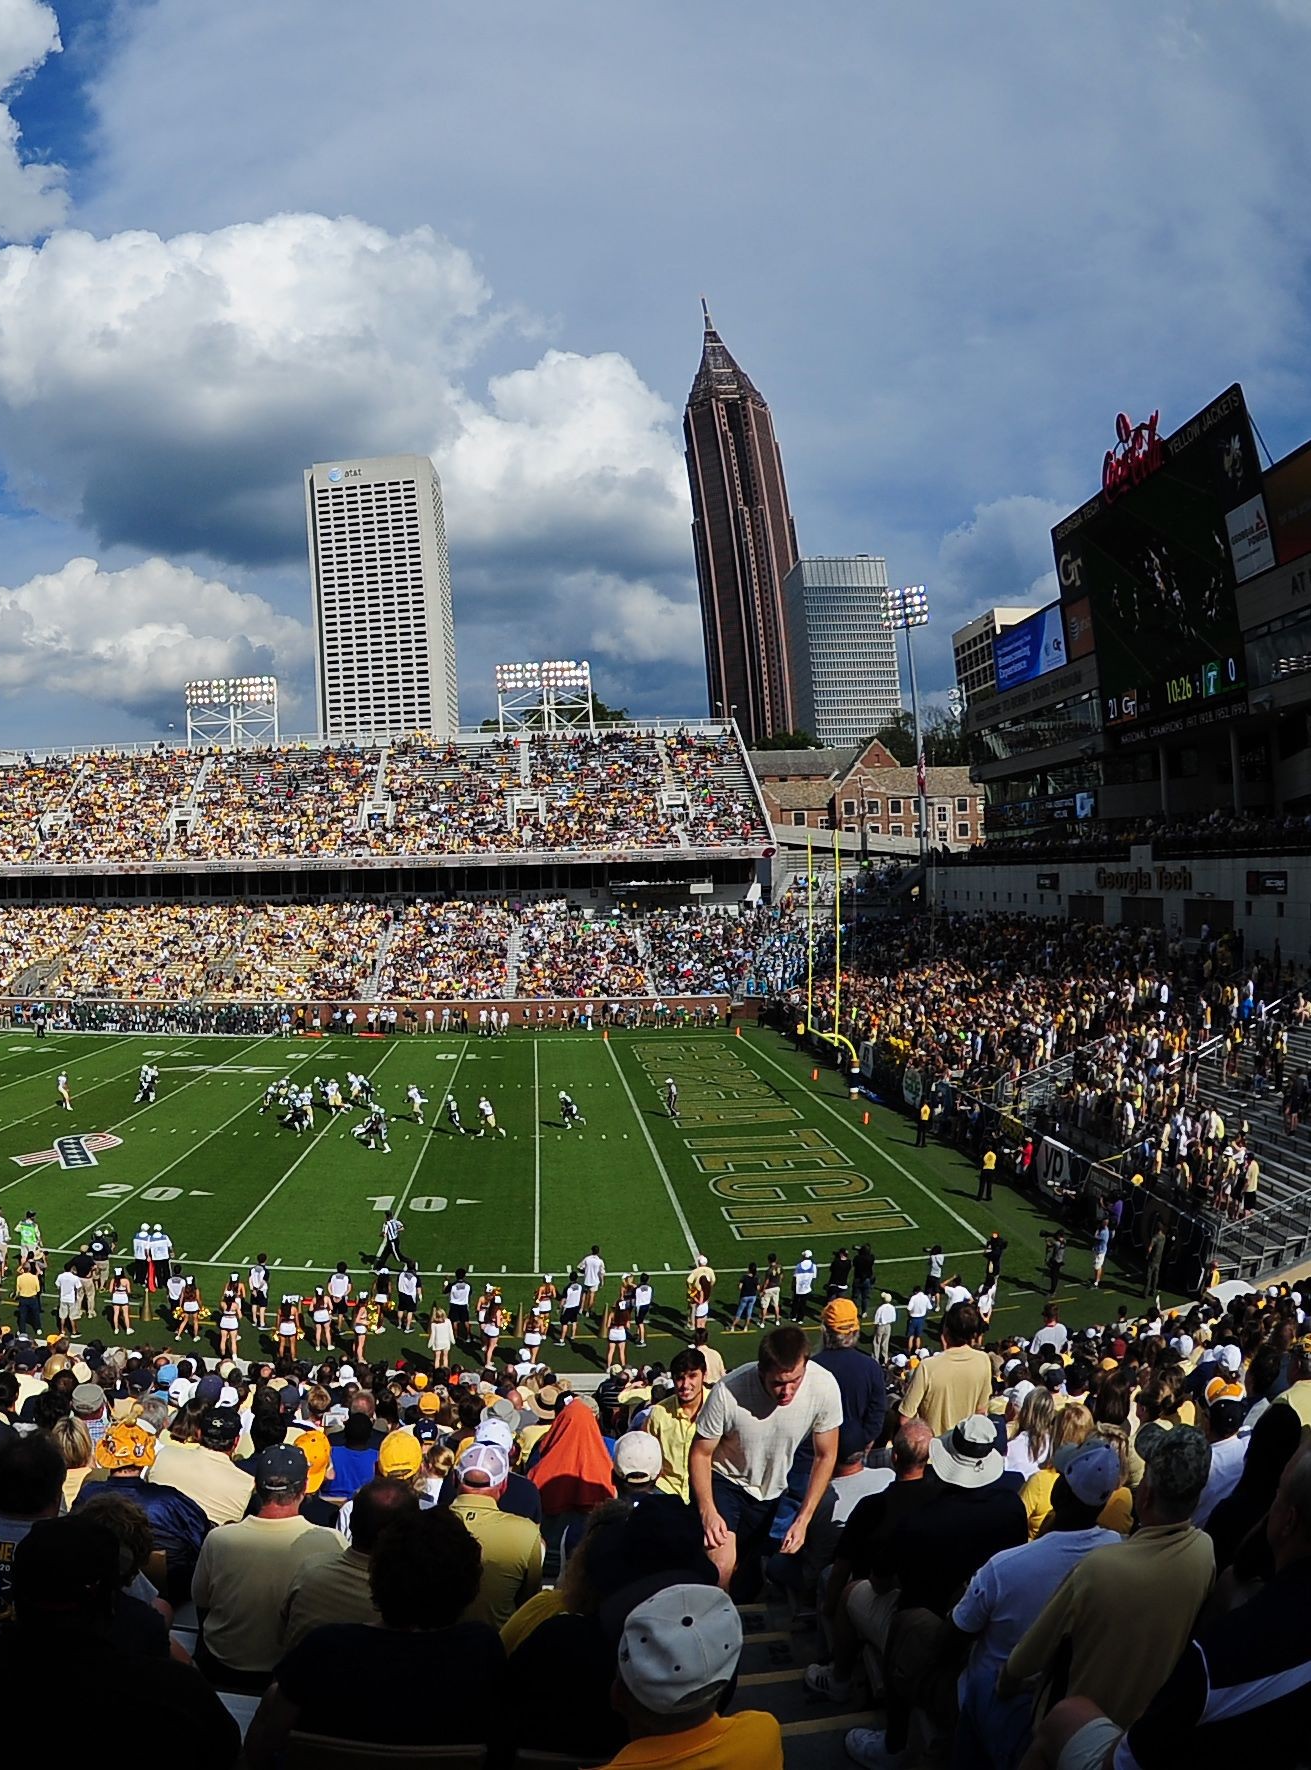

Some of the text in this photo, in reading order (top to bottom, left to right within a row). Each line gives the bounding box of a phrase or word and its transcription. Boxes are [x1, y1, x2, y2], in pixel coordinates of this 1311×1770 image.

[1168, 391, 1240, 456] YELLOW JACKETS
[1056, 497, 1101, 541] GEORGIA TECH
[1059, 550, 1083, 588] GT
[1291, 572, 1305, 596] AT
[1228, 657, 1236, 682] 0
[1166, 675, 1193, 704] 10:26
[1108, 697, 1118, 719] 21
[1122, 697, 1136, 716] GT
[1120, 729, 1148, 745] NATIONAL
[1149, 718, 1184, 738] CHAMPIONS
[1095, 866, 1192, 894] Georgia Tech
[630, 1041, 804, 1128] GEORGIA
[86, 1183, 184, 1201] 20
[682, 1128, 919, 1240] TECH
[365, 1195, 448, 1212] 10
